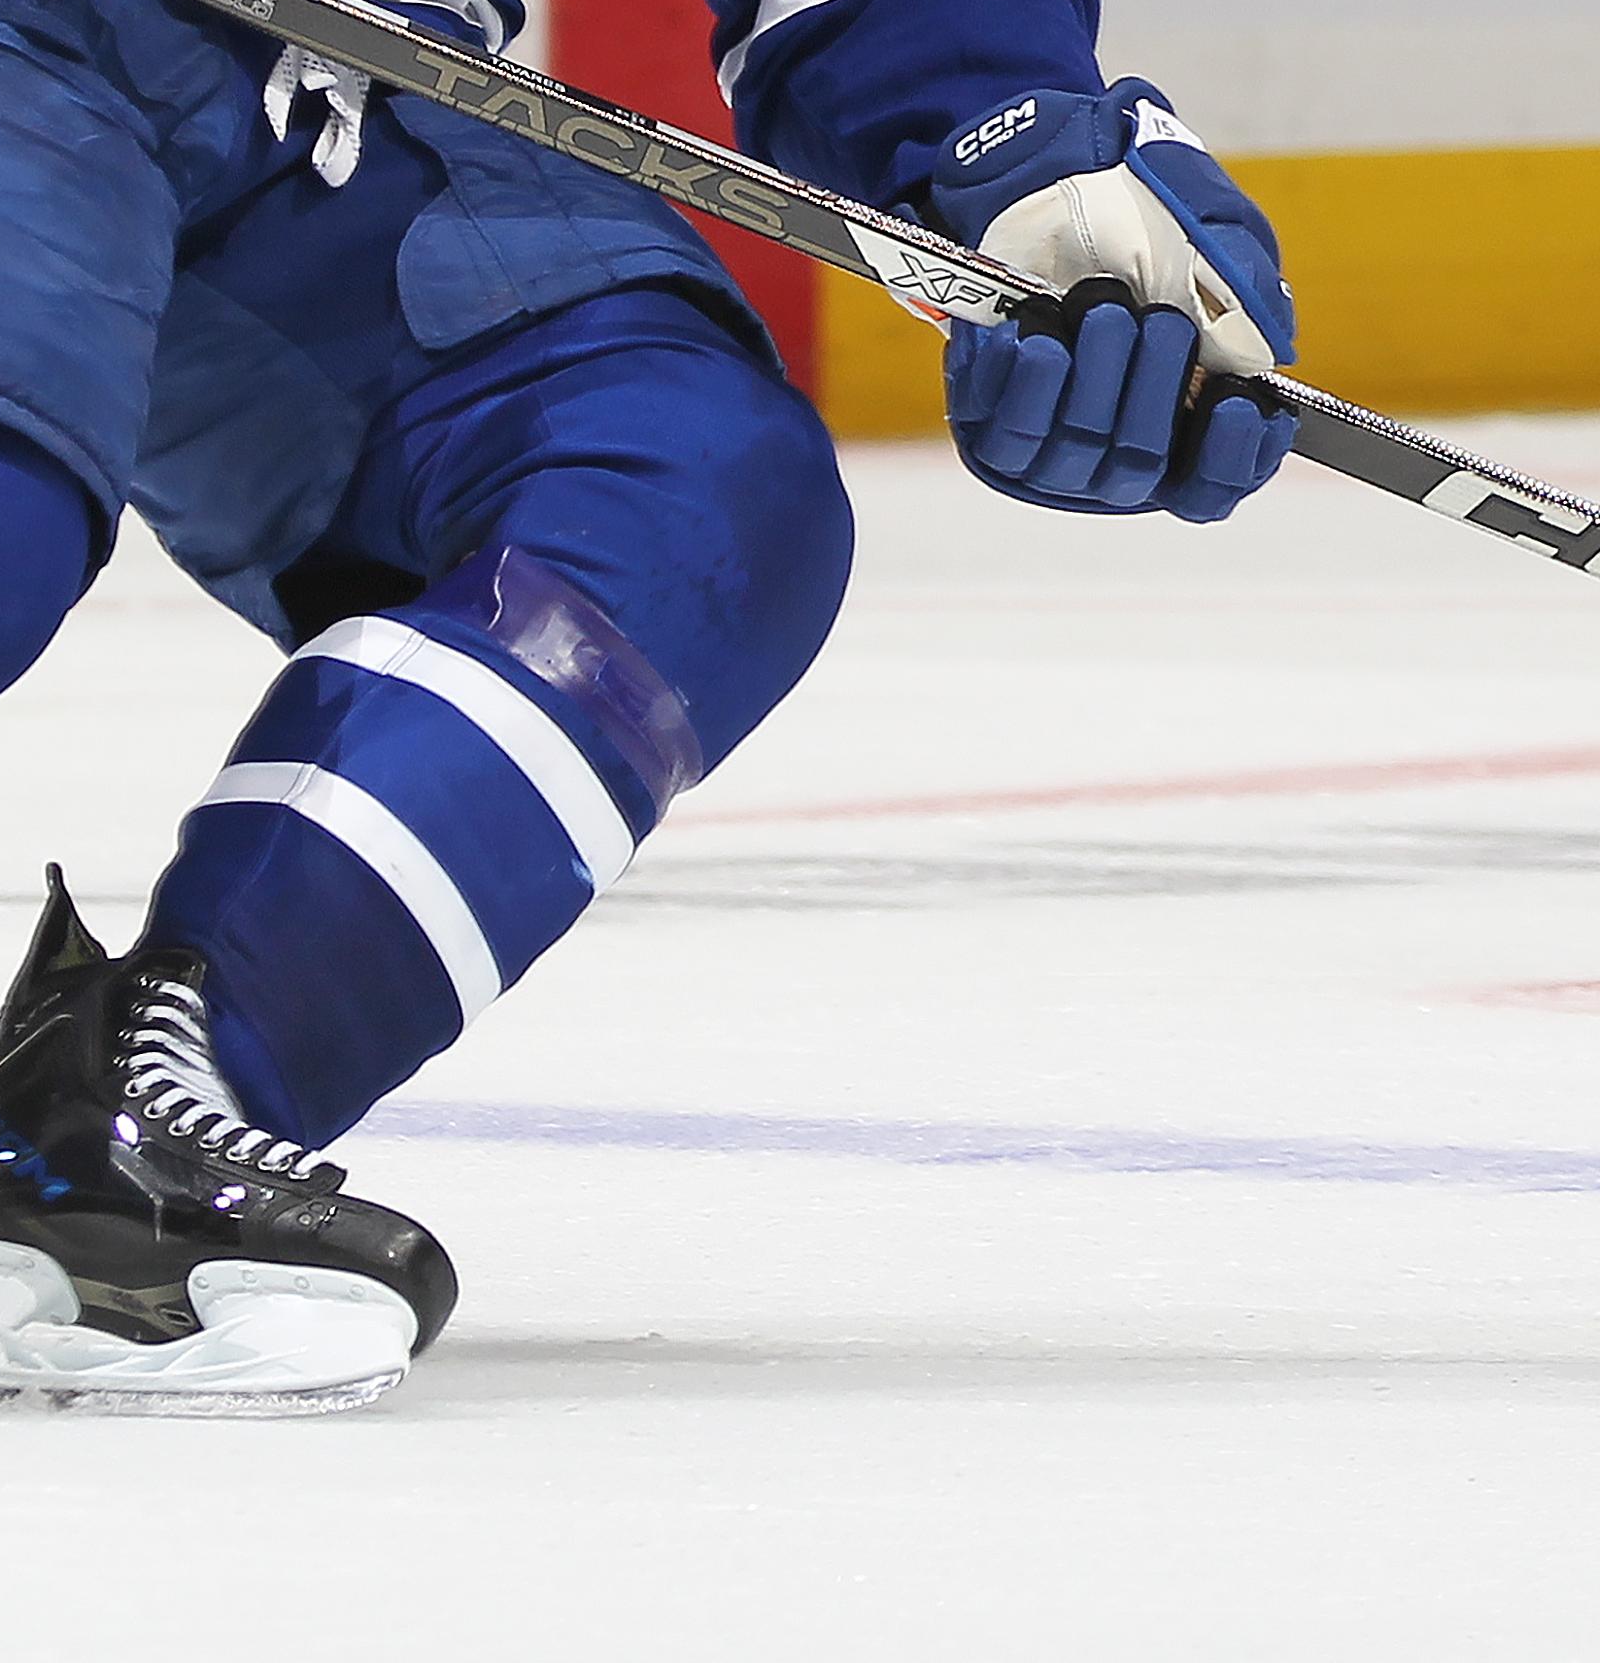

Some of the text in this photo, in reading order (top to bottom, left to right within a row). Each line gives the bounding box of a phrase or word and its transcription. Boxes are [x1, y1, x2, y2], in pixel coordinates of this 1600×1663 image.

[415, 48, 790, 240] TACKS
[955, 98, 1036, 160] CCM
[1152, 117, 1176, 137] 15
